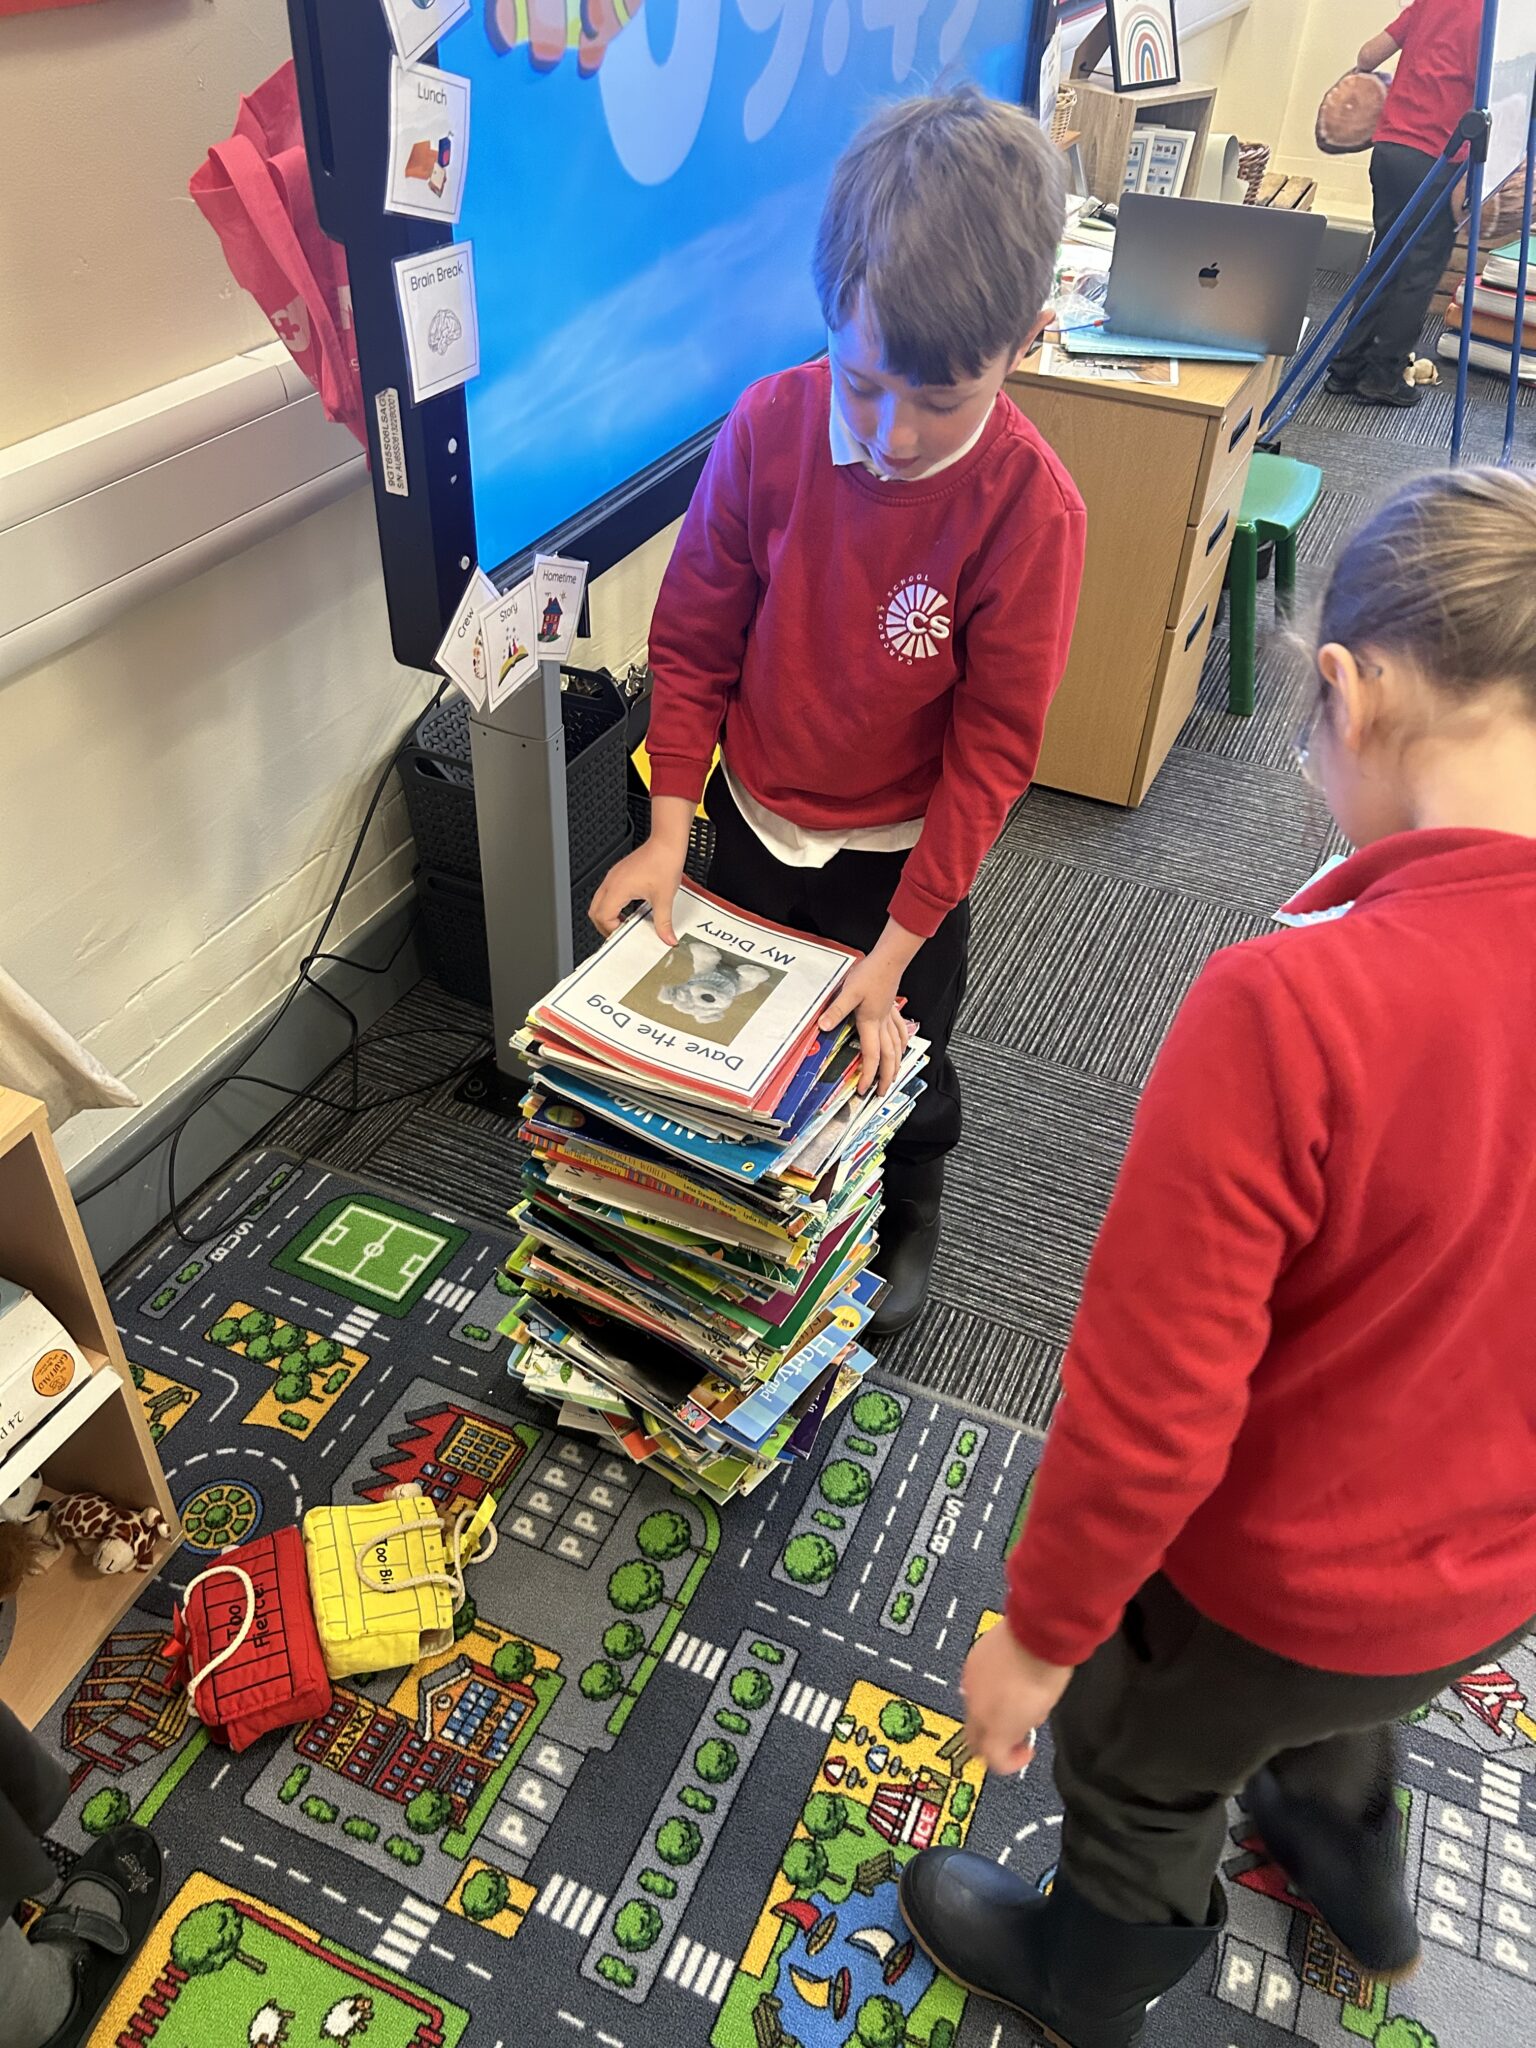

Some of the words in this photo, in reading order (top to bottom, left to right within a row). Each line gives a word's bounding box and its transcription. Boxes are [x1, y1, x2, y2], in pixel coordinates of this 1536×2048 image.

[417, 82, 447, 105] Lunch
[410, 271, 436, 291] Brain
[436, 261, 464, 282] Break
[543, 569, 577, 584] Hometime
[457, 607, 474, 638] Crew
[499, 602, 518, 623] Story
[905, 611, 951, 639] CS
[696, 921, 756, 953] Diary
[760, 946, 796, 965] My
[586, 994, 632, 1028] Dog
[637, 1023, 676, 1046] the
[684, 1042, 744, 1071] Dave
[209, 1221, 254, 1262] BUS
[39, 1352, 70, 1391] GRUFFALO
[778, 1333, 837, 1382] Harry
[760, 1379, 781, 1402] and
[8, 1410, 25, 1430] 24
[543, 1467, 568, 1488] P
[528, 1492, 553, 1513] P
[589, 1486, 613, 1508] P
[512, 1516, 537, 1540] P
[573, 1511, 597, 1533] P
[930, 1498, 964, 1555] BUS
[375, 1538, 388, 1562] Too
[558, 1535, 583, 1559] P
[379, 1569, 397, 1594] Bi!
[226, 1604, 243, 1641] Too
[326, 1709, 372, 1768] BANK
[536, 1745, 565, 1775] P
[517, 1779, 547, 1811] P
[498, 1813, 529, 1846] P
[912, 1805, 939, 1846] ICE
[1441, 1806, 1473, 1838] P
[1438, 1840, 1471, 1871] P
[1504, 1833, 1534, 1862] P
[1435, 1875, 1467, 1907] P
[1501, 1866, 1533, 1898] P
[1429, 1911, 1462, 1945] P
[1498, 1901, 1531, 1934] P
[1494, 1937, 1528, 1972] P
[1227, 1954, 1254, 1992] P
[1264, 1973, 1292, 2010] P
